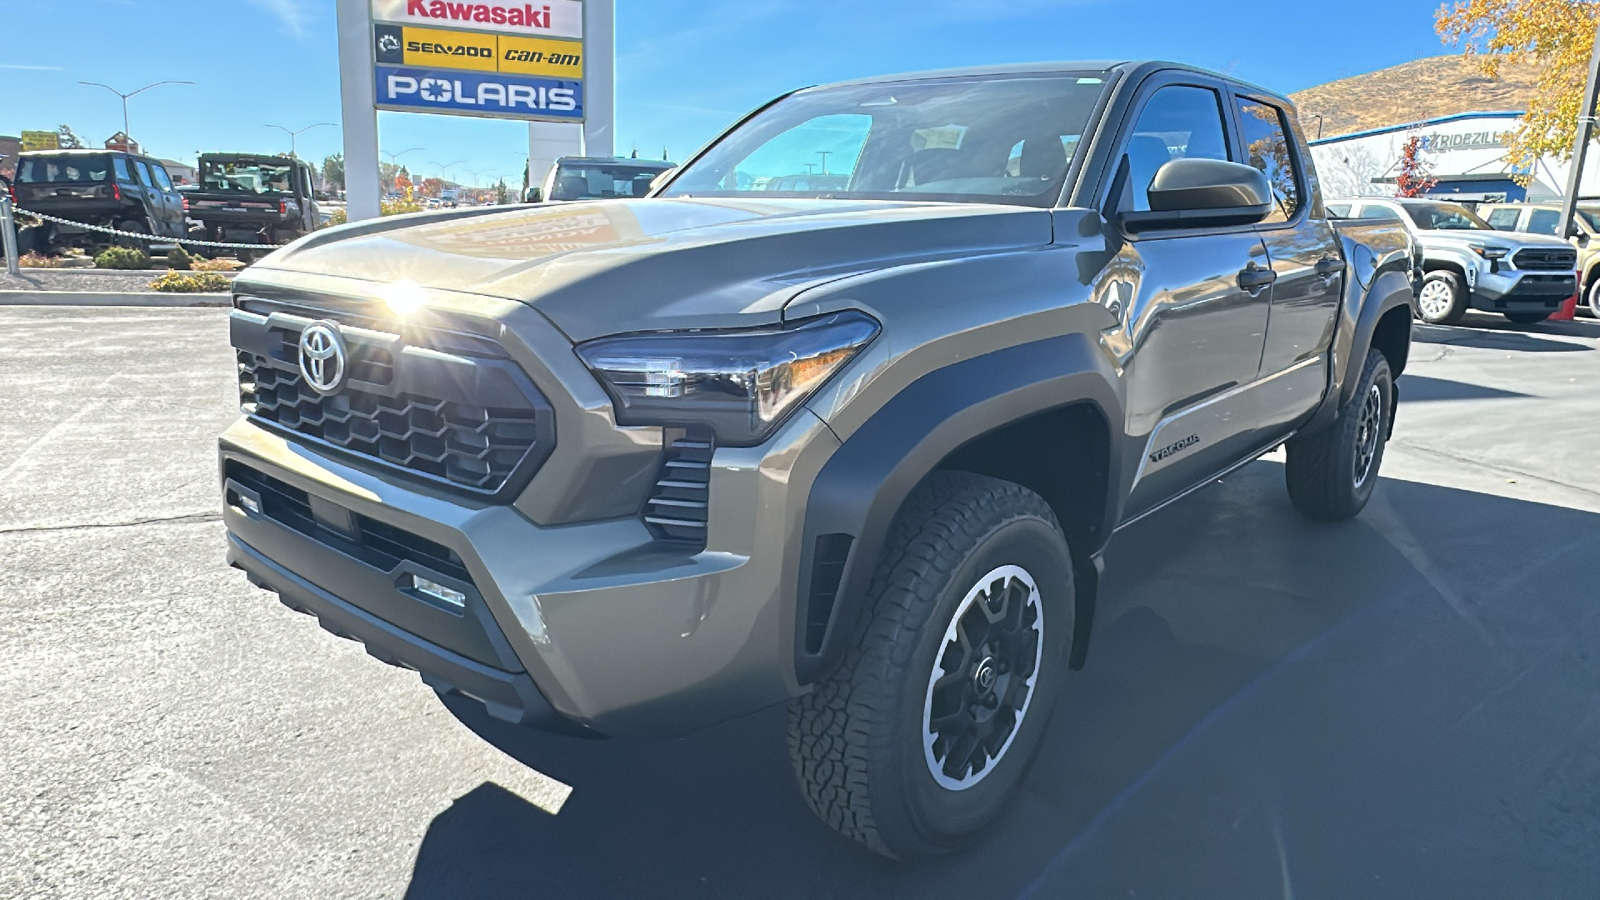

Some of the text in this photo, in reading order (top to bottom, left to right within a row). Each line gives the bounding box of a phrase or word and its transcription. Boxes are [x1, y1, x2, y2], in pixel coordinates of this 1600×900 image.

[407, 0, 551, 28] Kawasaki
[387, 75, 577, 112] POLARIS
[1149, 434, 1200, 462] TACOMA
